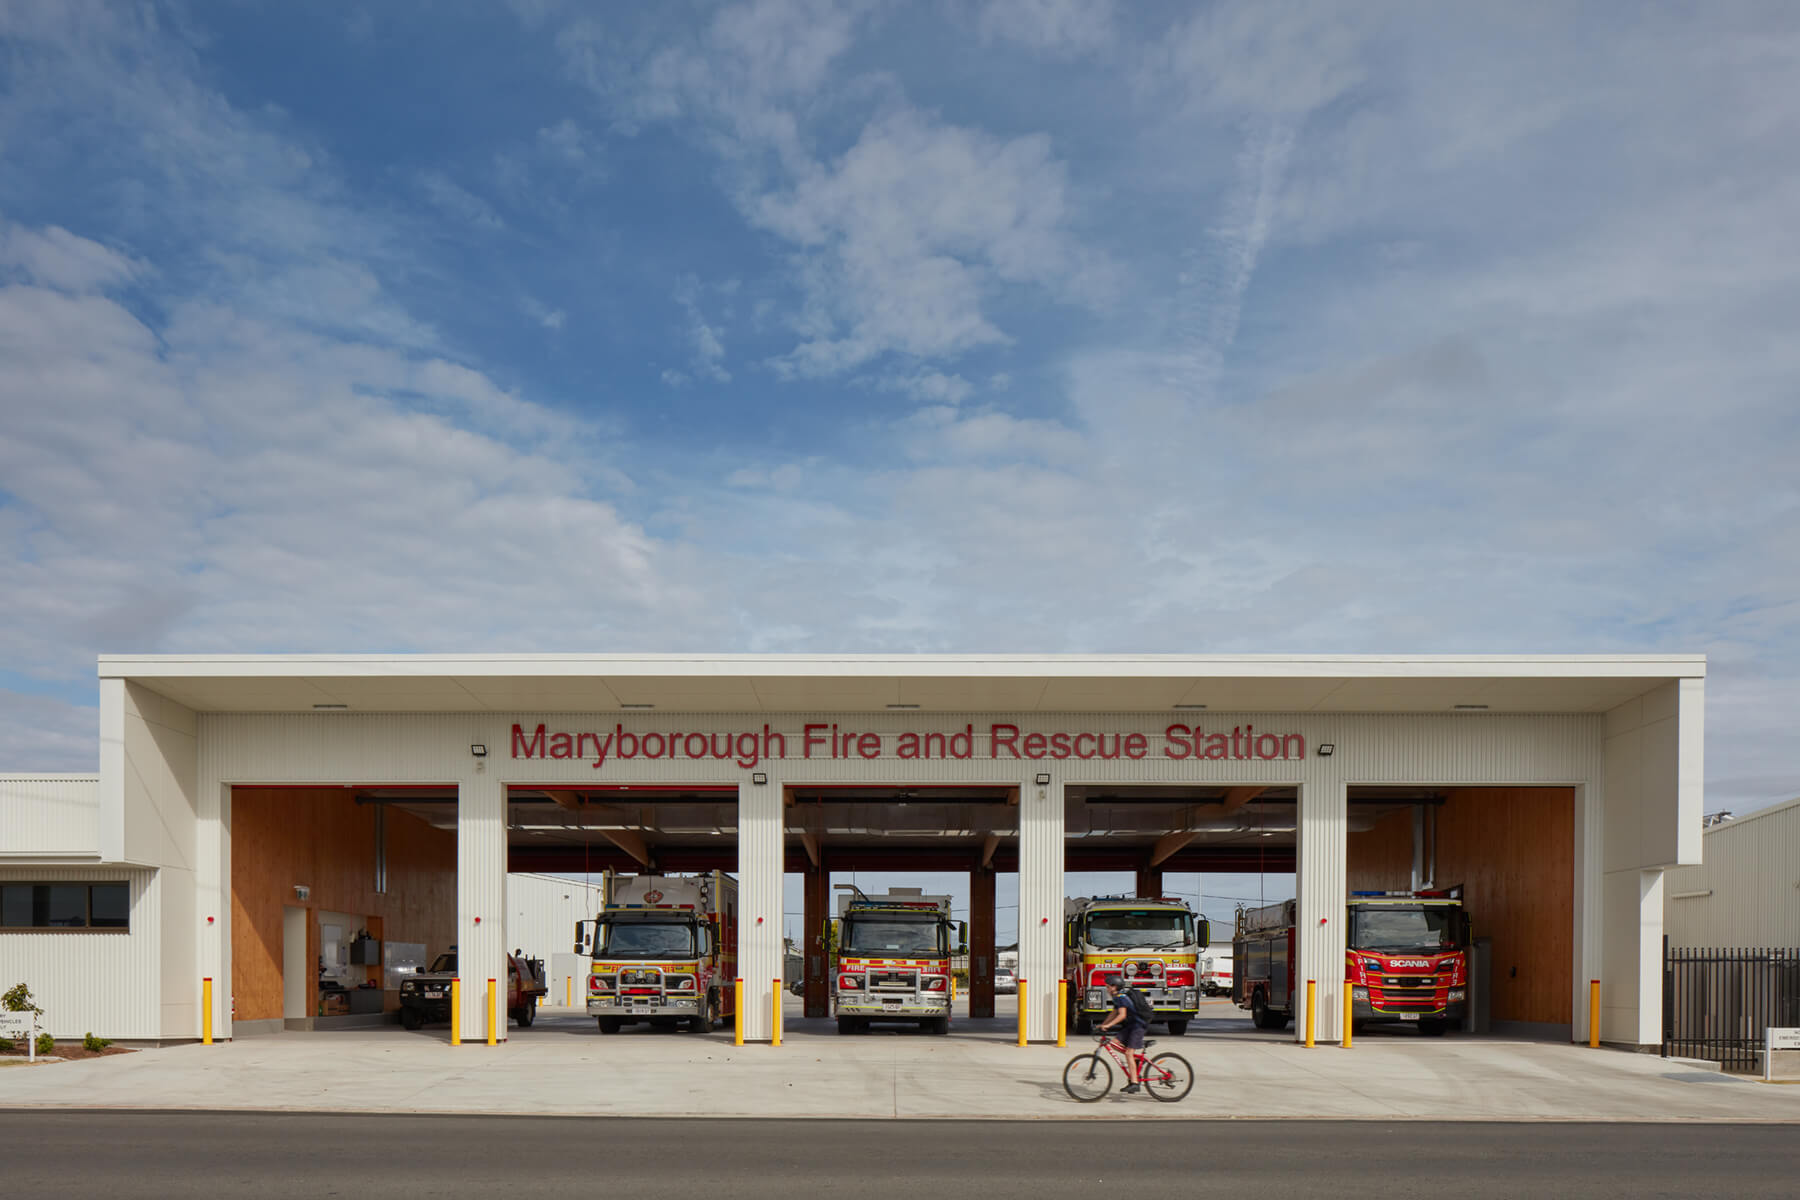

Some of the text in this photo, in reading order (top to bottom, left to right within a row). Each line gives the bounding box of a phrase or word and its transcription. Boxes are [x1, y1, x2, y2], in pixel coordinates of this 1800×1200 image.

[511, 724, 1306, 768] Maryborough Fire and Rescue Station
[1389, 960, 1430, 968] SCANIA
